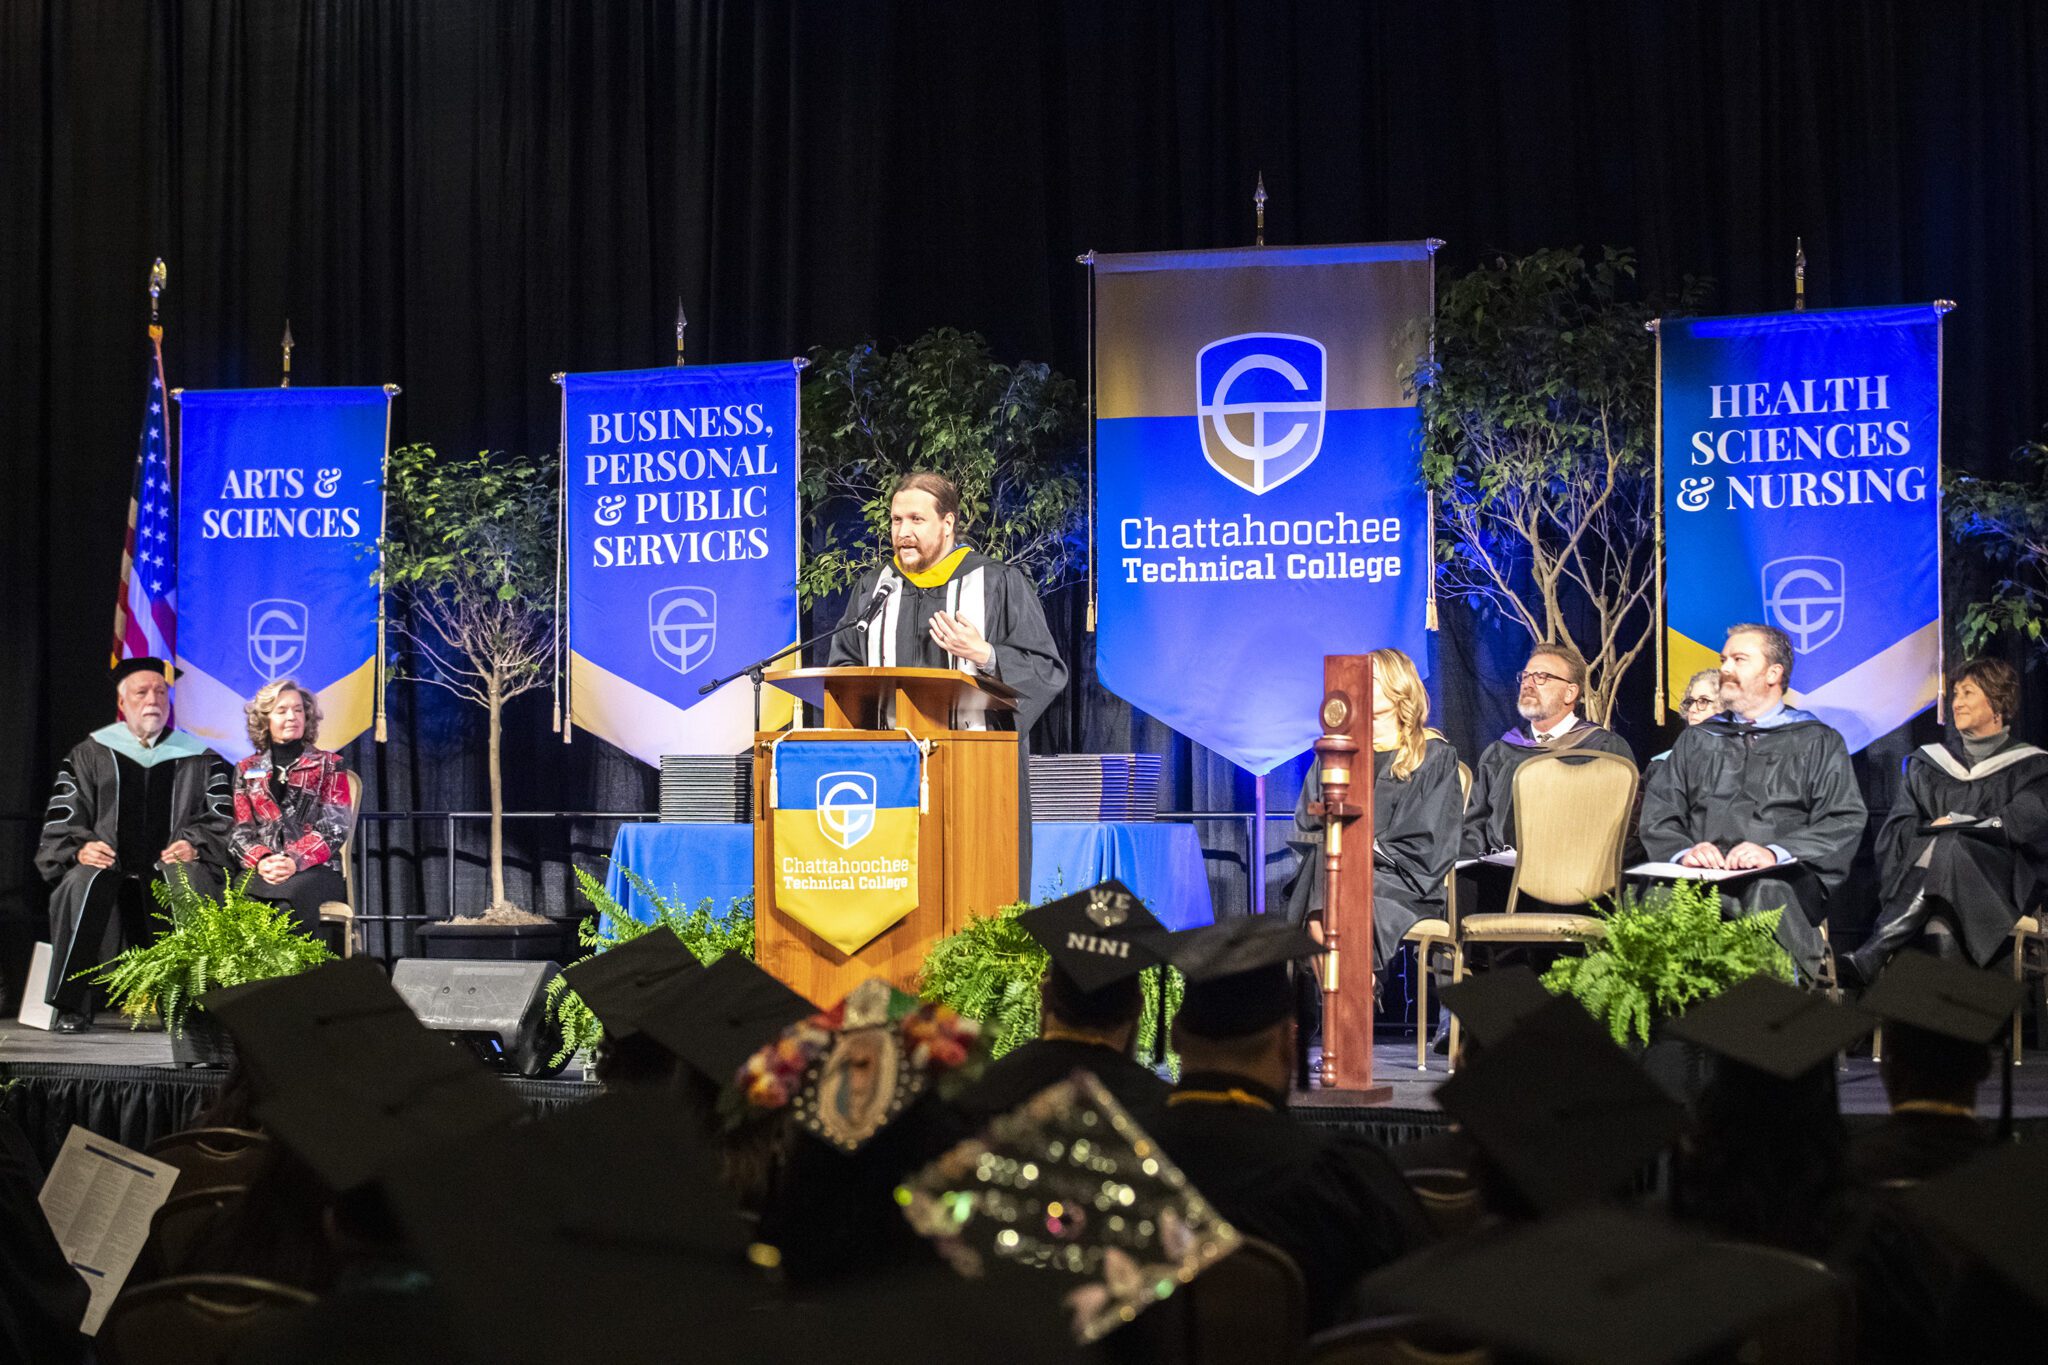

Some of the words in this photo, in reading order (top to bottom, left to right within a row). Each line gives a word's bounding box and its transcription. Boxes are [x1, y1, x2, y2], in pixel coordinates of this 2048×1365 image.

[1709, 375, 1891, 419] HEALTH
[588, 403, 775, 445] BUSINESS,
[1691, 420, 1911, 466] SCIENCES
[220, 467, 305, 500] ARTS
[313, 467, 342, 499] &
[585, 445, 778, 486] PERSONAL
[593, 494, 627, 527] &
[635, 485, 768, 525] PUBLIC
[1676, 476, 1715, 512] &
[1726, 466, 1926, 510] NURSING
[202, 507, 361, 539] SCIENCES
[1120, 511, 1401, 550] Chattahoochee
[593, 527, 770, 568] SERVICES
[1122, 553, 1276, 583] Technical
[1286, 551, 1401, 583] College
[783, 856, 909, 874] Chattahoochee
[784, 876, 855, 890] Technical
[859, 876, 908, 891] College
[1066, 931, 1131, 959] NINI
